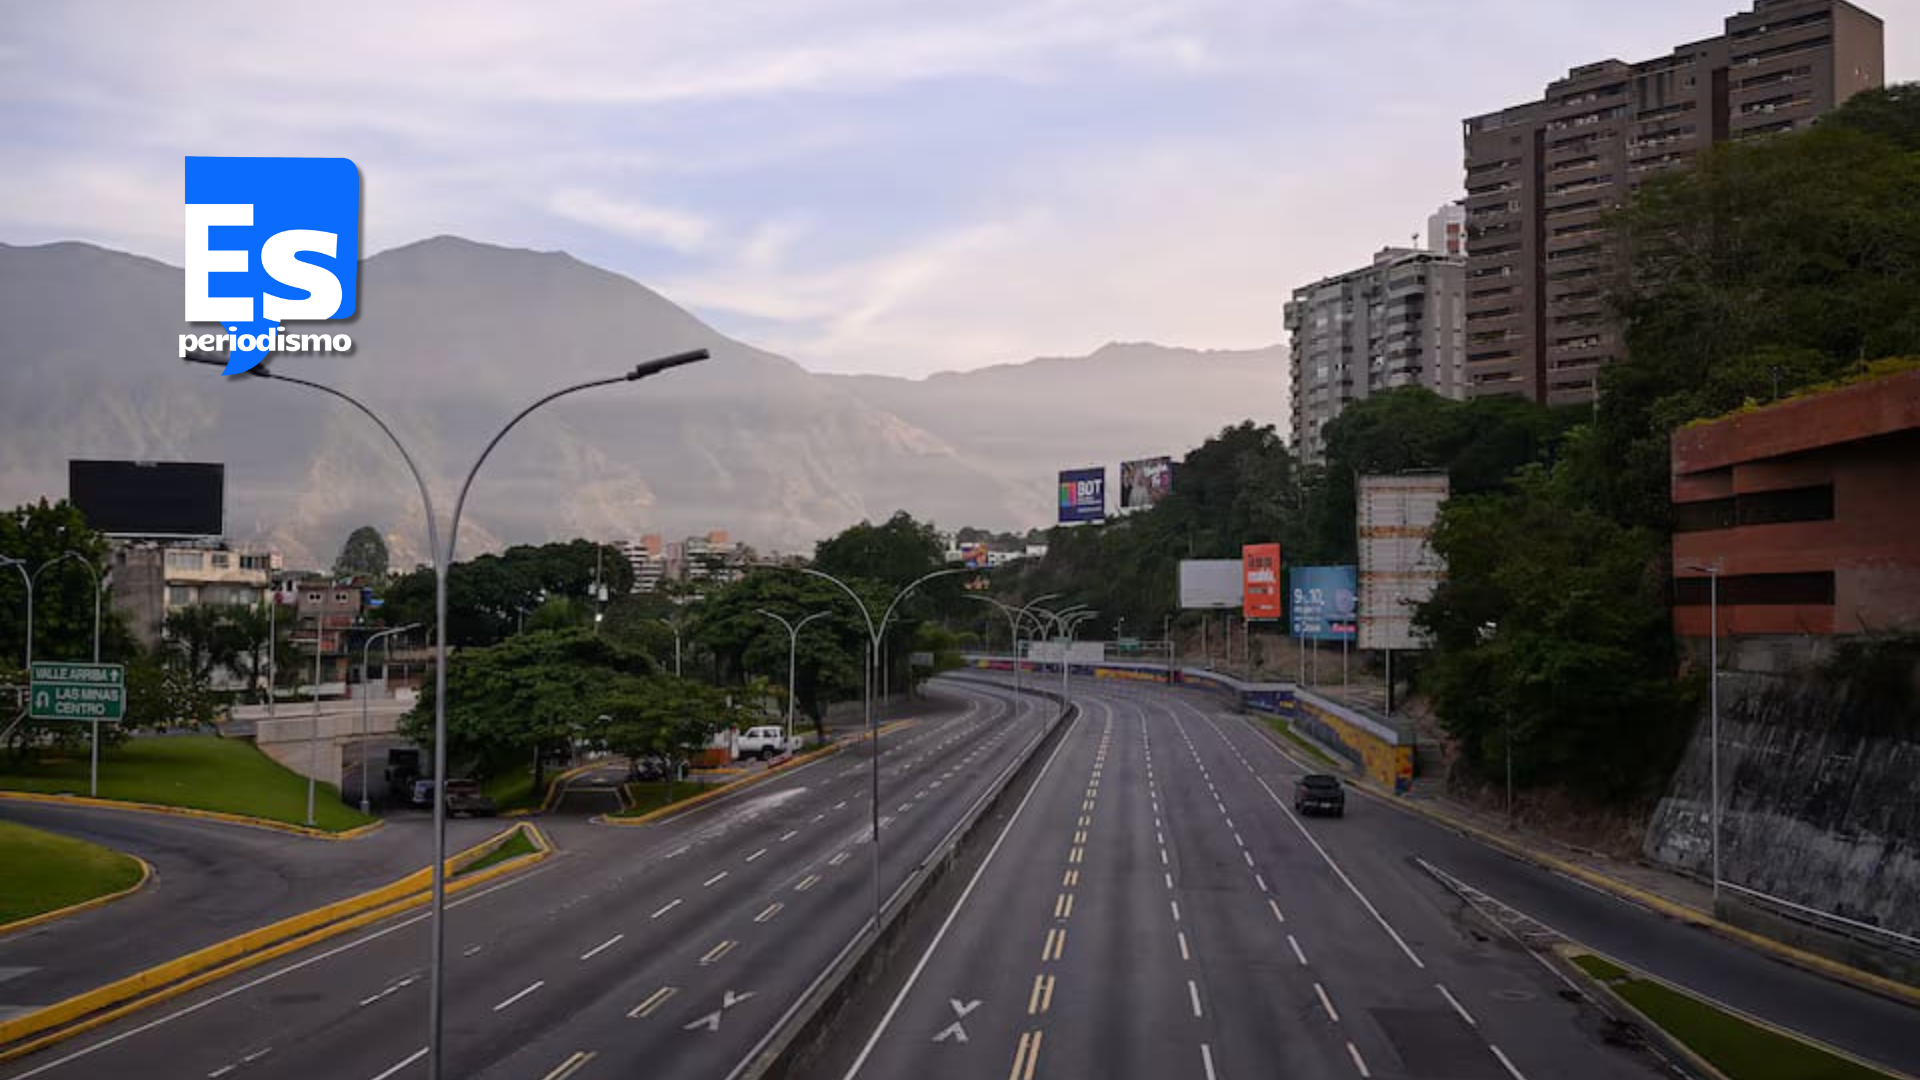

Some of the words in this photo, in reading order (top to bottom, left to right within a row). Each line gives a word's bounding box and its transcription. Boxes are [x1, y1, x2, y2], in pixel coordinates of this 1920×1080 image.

[1077, 479, 1102, 496] BOT
[35, 668, 68, 680] VALLE
[69, 669, 107, 681] ARRIBA
[55, 688, 79, 700] LAS
[81, 688, 119, 702] MINAS
[55, 702, 105, 715] CENTRO
